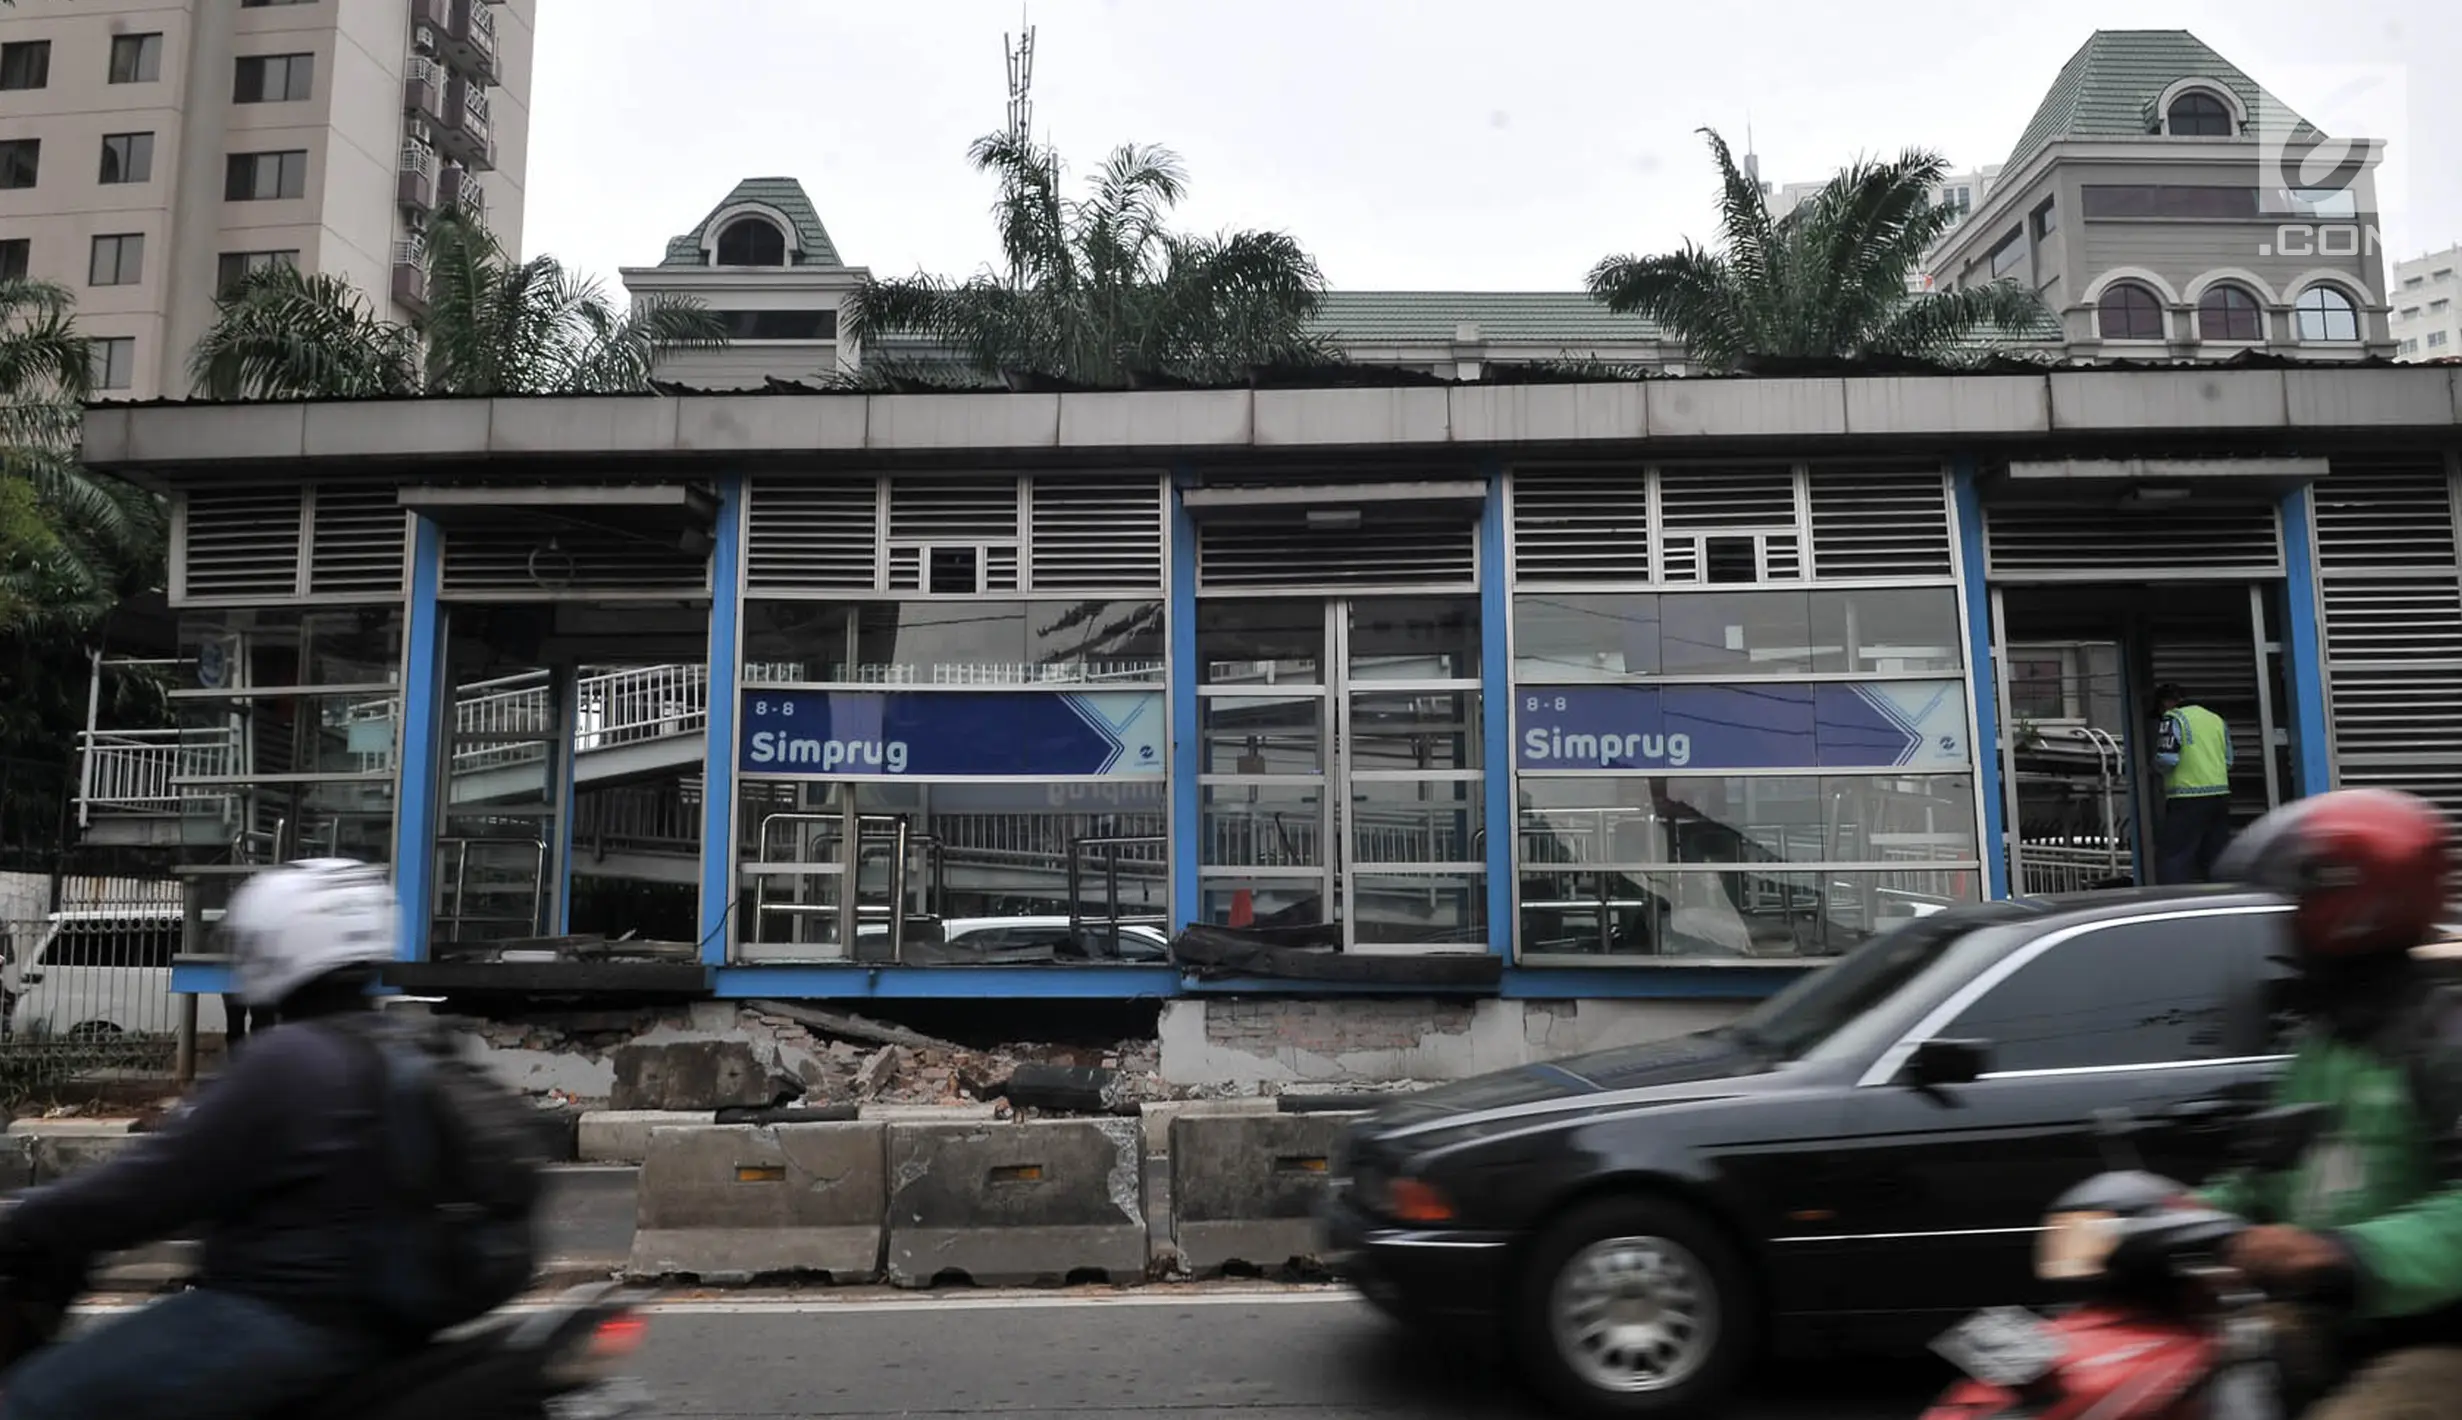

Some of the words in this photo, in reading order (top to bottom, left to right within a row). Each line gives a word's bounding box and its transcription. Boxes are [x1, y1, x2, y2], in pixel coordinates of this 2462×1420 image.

[755, 701, 767, 716] 8
[782, 701, 794, 716] 8
[1526, 697, 1538, 711] 8
[1554, 697, 1566, 711] 8
[750, 730, 908, 772] Simprug
[1525, 726, 1690, 766] Simprug
